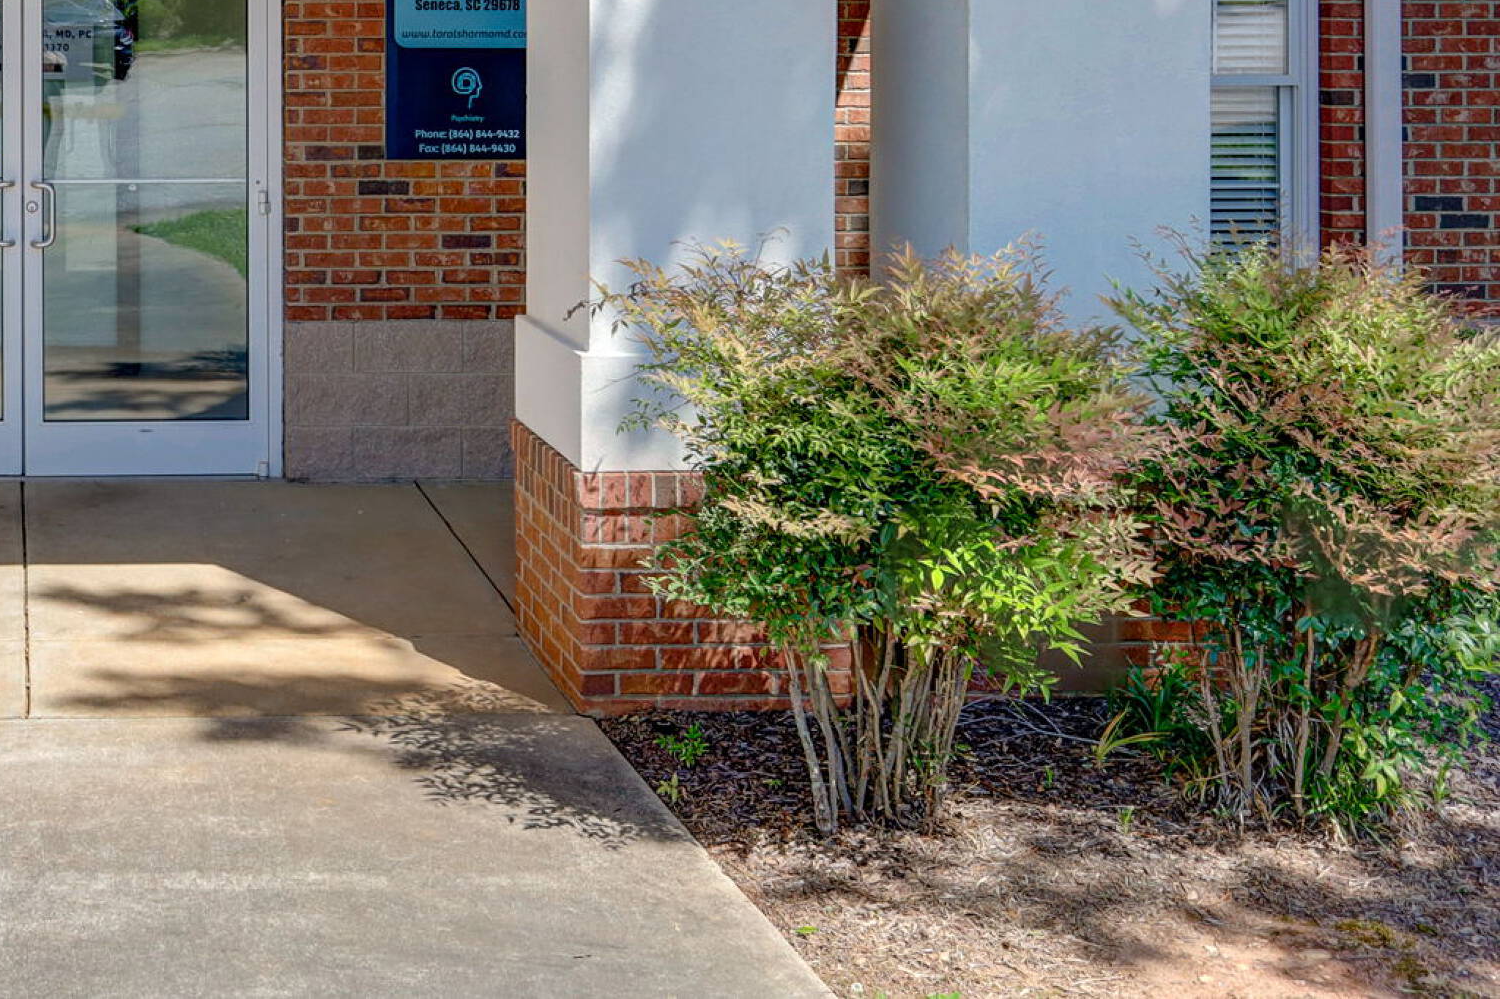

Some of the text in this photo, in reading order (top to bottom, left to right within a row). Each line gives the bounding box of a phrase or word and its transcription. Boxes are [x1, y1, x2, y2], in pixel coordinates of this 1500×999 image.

[78, 29, 92, 39] PC
[415, 129, 520, 140] Phone: (864) 844-9432
[419, 143, 516, 155] Fax: (864) 844-9430
